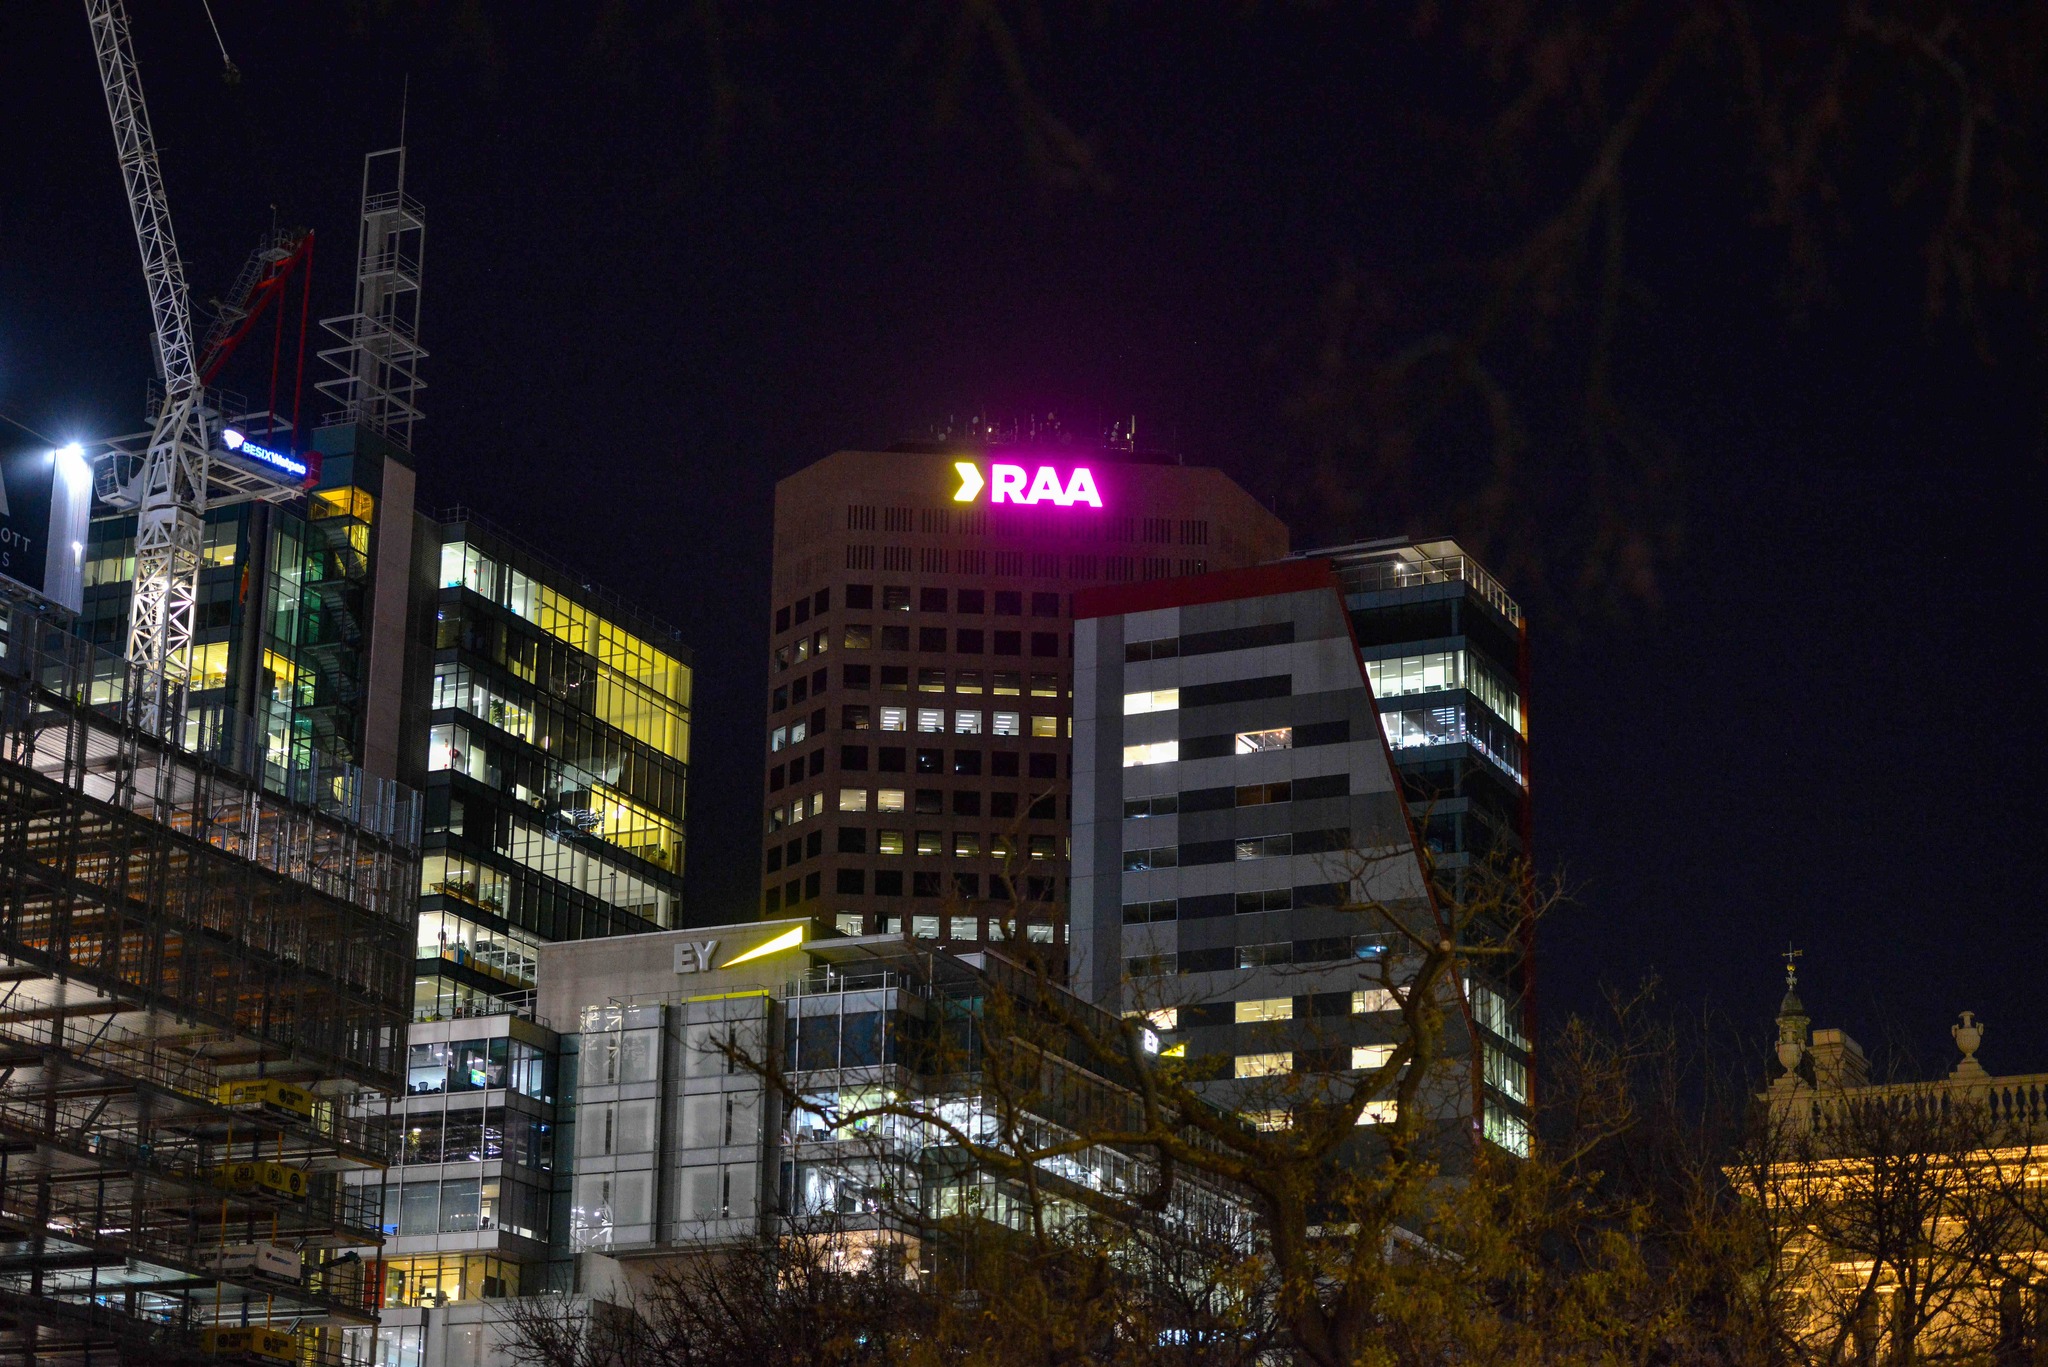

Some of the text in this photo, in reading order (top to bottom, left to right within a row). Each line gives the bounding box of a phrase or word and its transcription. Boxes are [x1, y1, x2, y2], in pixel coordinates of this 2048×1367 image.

[992, 464, 1103, 507] RAA
[0, 527, 31, 552] OTT
[673, 940, 719, 974] EY
